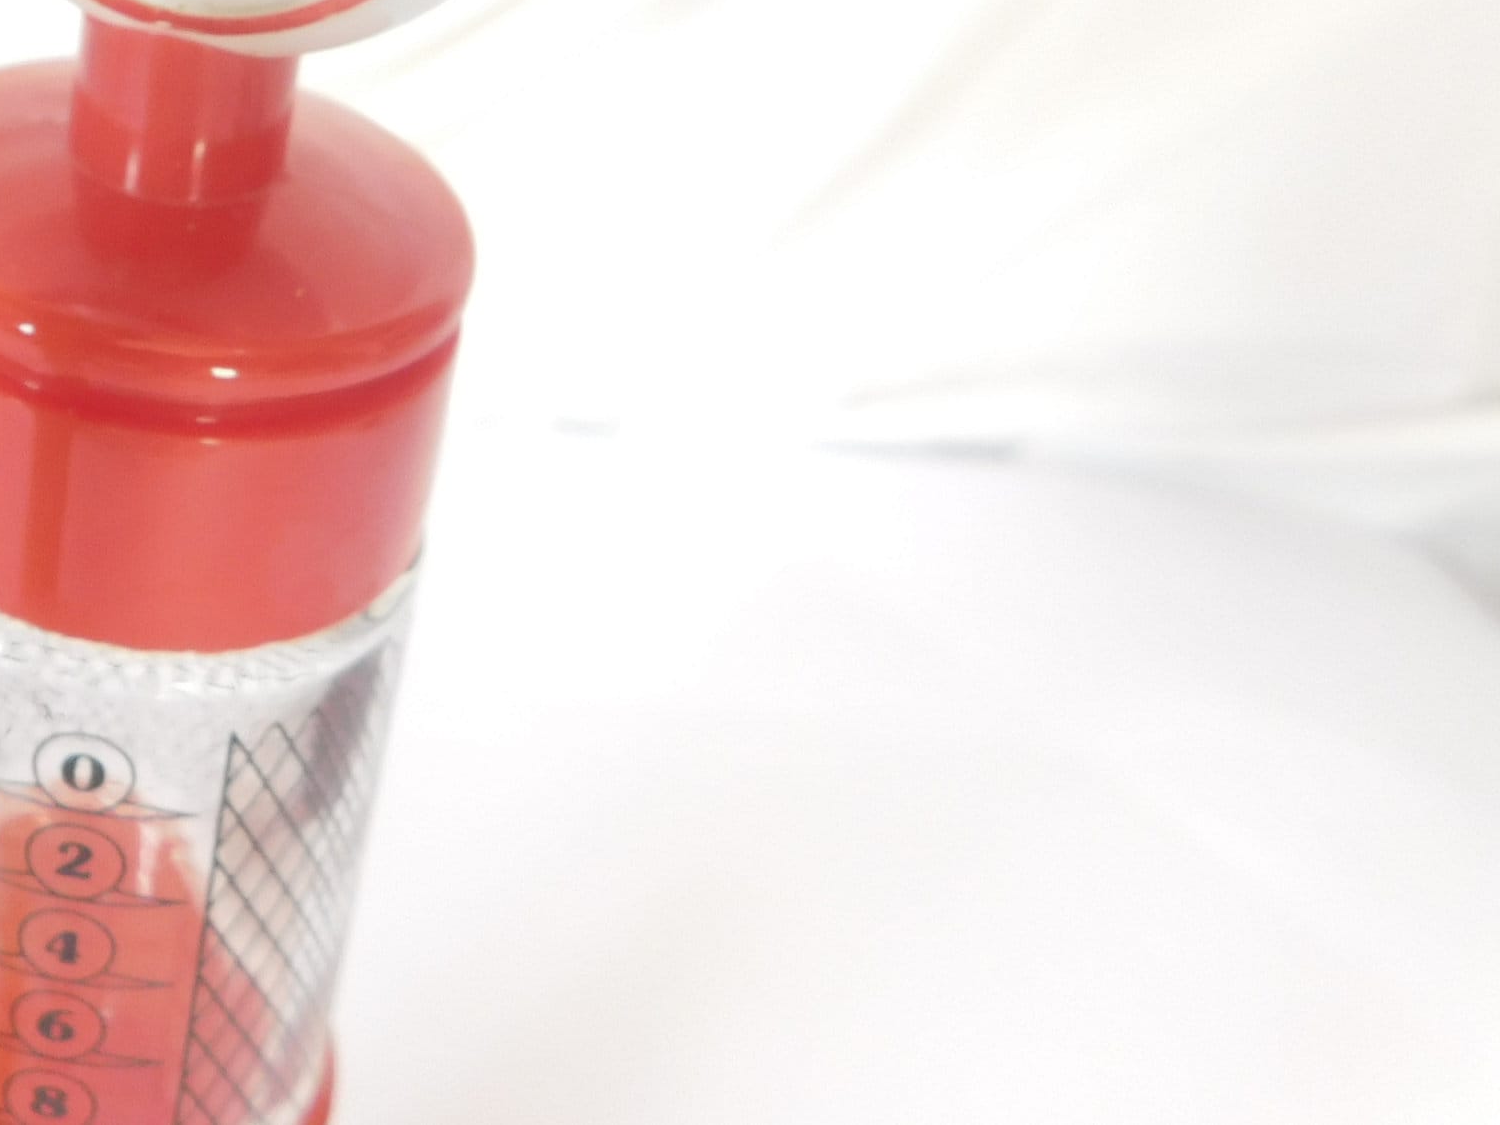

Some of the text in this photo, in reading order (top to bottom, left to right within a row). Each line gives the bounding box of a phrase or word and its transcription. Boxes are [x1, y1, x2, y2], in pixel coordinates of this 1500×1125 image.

[61, 754, 105, 792] 0
[56, 841, 93, 880] 2
[45, 931, 81, 964] 4
[36, 1009, 76, 1042] 6
[30, 1085, 68, 1120] 8
